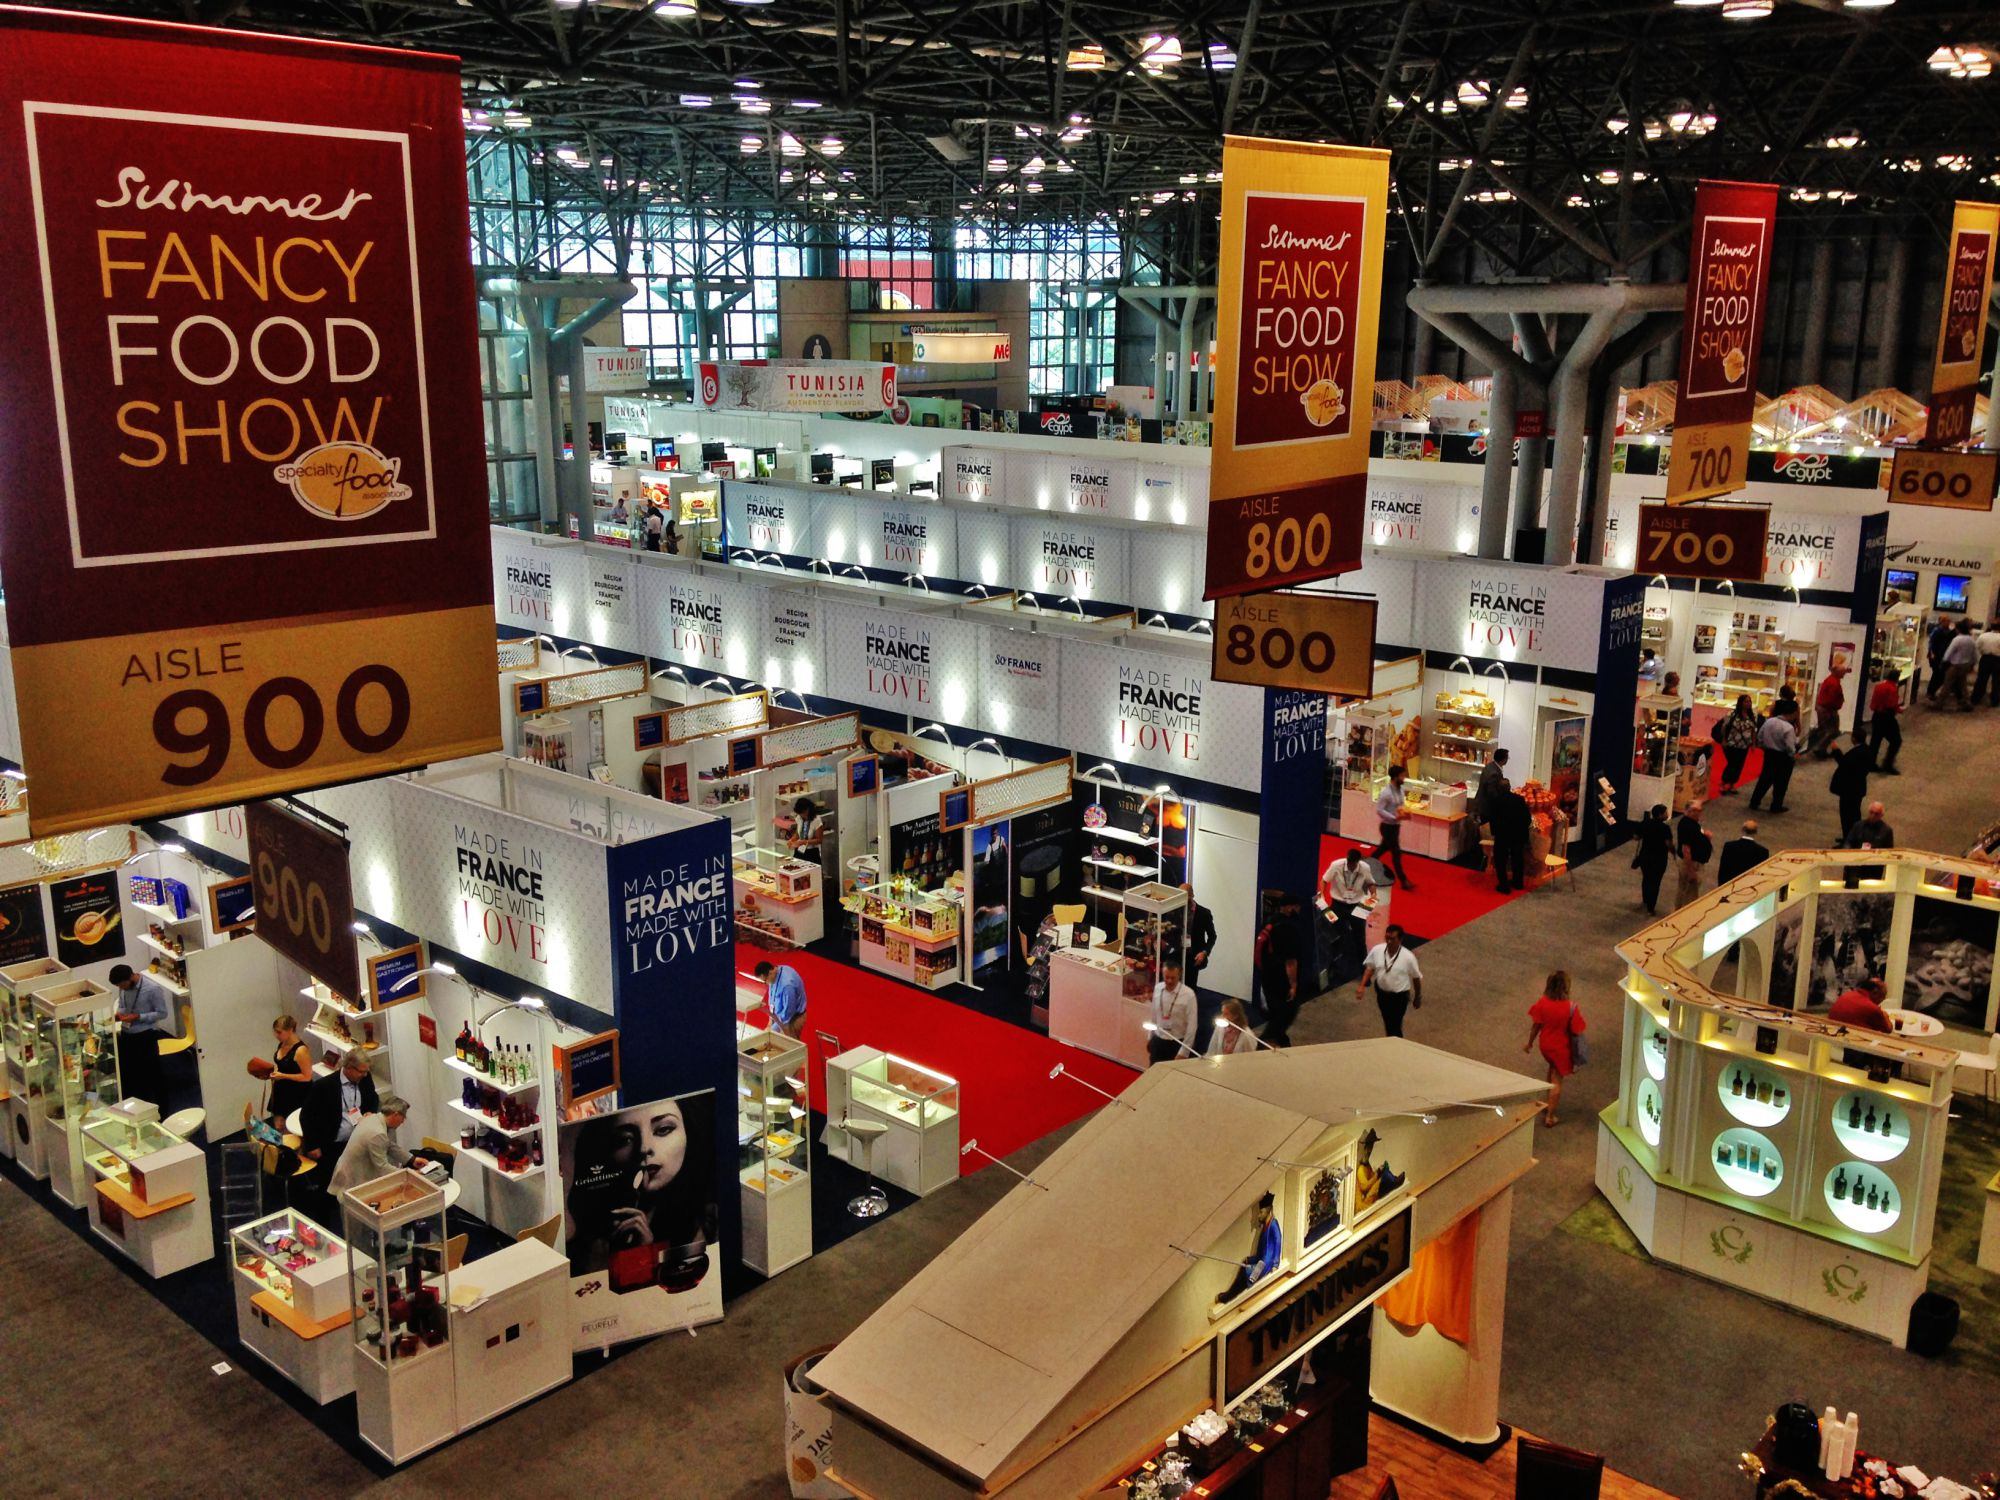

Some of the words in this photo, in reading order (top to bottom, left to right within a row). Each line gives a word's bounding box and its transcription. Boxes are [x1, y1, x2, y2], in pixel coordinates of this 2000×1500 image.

[96, 165, 373, 221] Summer
[1260, 223, 1352, 251] Summer
[1710, 239, 1756, 257] Summer
[97, 229, 374, 303] FANCY
[1257, 260, 1350, 300] FANCY
[1706, 264, 1754, 292] FANCY
[1703, 296, 1749, 326] FOOD
[1952, 290, 1980, 313] FOOD
[1255, 306, 1345, 349] FOOD
[107, 314, 381, 386] FOOD
[1700, 329, 1748, 359] SHOW
[597, 357, 643, 371] TUNISIA
[1252, 352, 1343, 395] SHOW
[787, 375, 864, 391] TUNISIA
[608, 406, 646, 418] TUNISIA
[1936, 404, 1964, 439] 600
[116, 396, 383, 468] SHOW
[1048, 421, 1073, 436] Egypt
[957, 463, 992, 476] FRANCE
[1070, 465, 1096, 474] MADE
[1100, 468, 1109, 476] IN
[1070, 473, 1109, 486] FRANCE
[1687, 445, 1732, 492] 700
[1786, 463, 1833, 482] Egypt
[278, 462, 343, 480] specialty
[333, 452, 397, 518] food
[1070, 484, 1090, 493] MADE
[1092, 486, 1109, 495] WITH
[1899, 469, 1972, 498] 600
[776, 498, 784, 506] IN
[1071, 492, 1109, 508] LOVE
[1239, 496, 1281, 519] AISLE
[1371, 490, 1404, 501] MADE
[1411, 494, 1423, 502] IN
[1371, 500, 1422, 515] FRANCE
[747, 503, 784, 519] FRANCE
[883, 511, 910, 523] MADE
[917, 516, 927, 525] IN
[1371, 512, 1396, 522] MADE
[1399, 515, 1421, 524] WITH
[884, 521, 926, 538] FRANCE
[1370, 521, 1420, 540] LOVE
[1651, 518, 1690, 529] AISLE
[1821, 525, 1836, 535] IN
[884, 535, 906, 545] MADE
[908, 538, 927, 548] WITH
[1043, 531, 1076, 543] MADE
[1083, 535, 1095, 546] IN
[1245, 512, 1332, 579] 800
[1648, 530, 1734, 566] 700
[1768, 532, 1835, 549] FRANCE
[885, 544, 926, 565] LOVE
[1043, 541, 1095, 560] FRANCE
[1803, 549, 1833, 561] WITH
[506, 555, 534, 570] MADE
[540, 561, 551, 573] IN
[1044, 555, 1069, 568] MADE
[1072, 559, 1095, 571] WITH
[1906, 555, 1931, 566] NEW
[1932, 557, 1982, 570] ZEALAND
[507, 567, 552, 589] FRANCE
[1045, 565, 1095, 589] LOVE
[1471, 579, 1519, 596] MADE
[1530, 586, 1547, 598] IN
[507, 583, 531, 597] MADE
[533, 589, 553, 601] WITH
[669, 585, 702, 602] MADE
[710, 593, 722, 605] IN
[509, 594, 553, 622] LOVE
[670, 598, 722, 623] FRANCE
[1229, 605, 1280, 623] AISLE
[1470, 592, 1546, 616] FRANCE
[1610, 600, 1643, 622] FRANCE
[671, 616, 698, 631] MADE
[701, 623, 722, 637] WITH
[774, 617, 810, 629] BOURGOGNE
[1469, 609, 1507, 625] MADE
[1512, 614, 1545, 629] WITH
[673, 628, 723, 659] LOVE
[779, 627, 806, 638] FRANCHE
[866, 621, 906, 640] MADE
[916, 631, 930, 644] IN
[1470, 622, 1542, 652] LOVE
[1609, 626, 1641, 650] LOVE
[866, 635, 930, 664] FRANCE
[1226, 624, 1336, 674] 800
[121, 642, 245, 688] AISLE
[867, 655, 898, 672] MADE
[902, 662, 930, 679] WITH
[1007, 657, 1042, 672] FRANCE
[867, 668, 931, 704] LOVE
[1119, 665, 1171, 688] MADE
[1184, 677, 1202, 693] IN
[1120, 681, 1200, 716] FRANCE
[1274, 691, 1307, 708] MADE
[1119, 703, 1160, 725] MADE
[1164, 712, 1200, 733] WITH
[1274, 698, 1325, 727] FRANCE
[152, 664, 412, 787] 900
[1273, 721, 1300, 740] MADE
[1302, 715, 1324, 731] WITH
[1120, 719, 1200, 761] LOVE
[1274, 728, 1323, 762] LOVE
[902, 825, 913, 833] The
[455, 824, 510, 860] MADE
[522, 846, 542, 870] IN
[456, 846, 544, 901] FRANCE
[624, 863, 690, 897] MADE
[704, 854, 725, 875] IN
[258, 851, 332, 954] 900
[459, 876, 503, 910] MADE
[506, 893, 546, 925] WITH
[624, 872, 726, 924] FRANCE
[626, 911, 679, 943] MADE
[683, 897, 727, 923] WITH
[463, 900, 548, 965] LOVE
[629, 915, 729, 975] LOVE
[376, 961, 401, 971] PREMIUM
[1248, 1232, 1390, 1366] TWININGS
